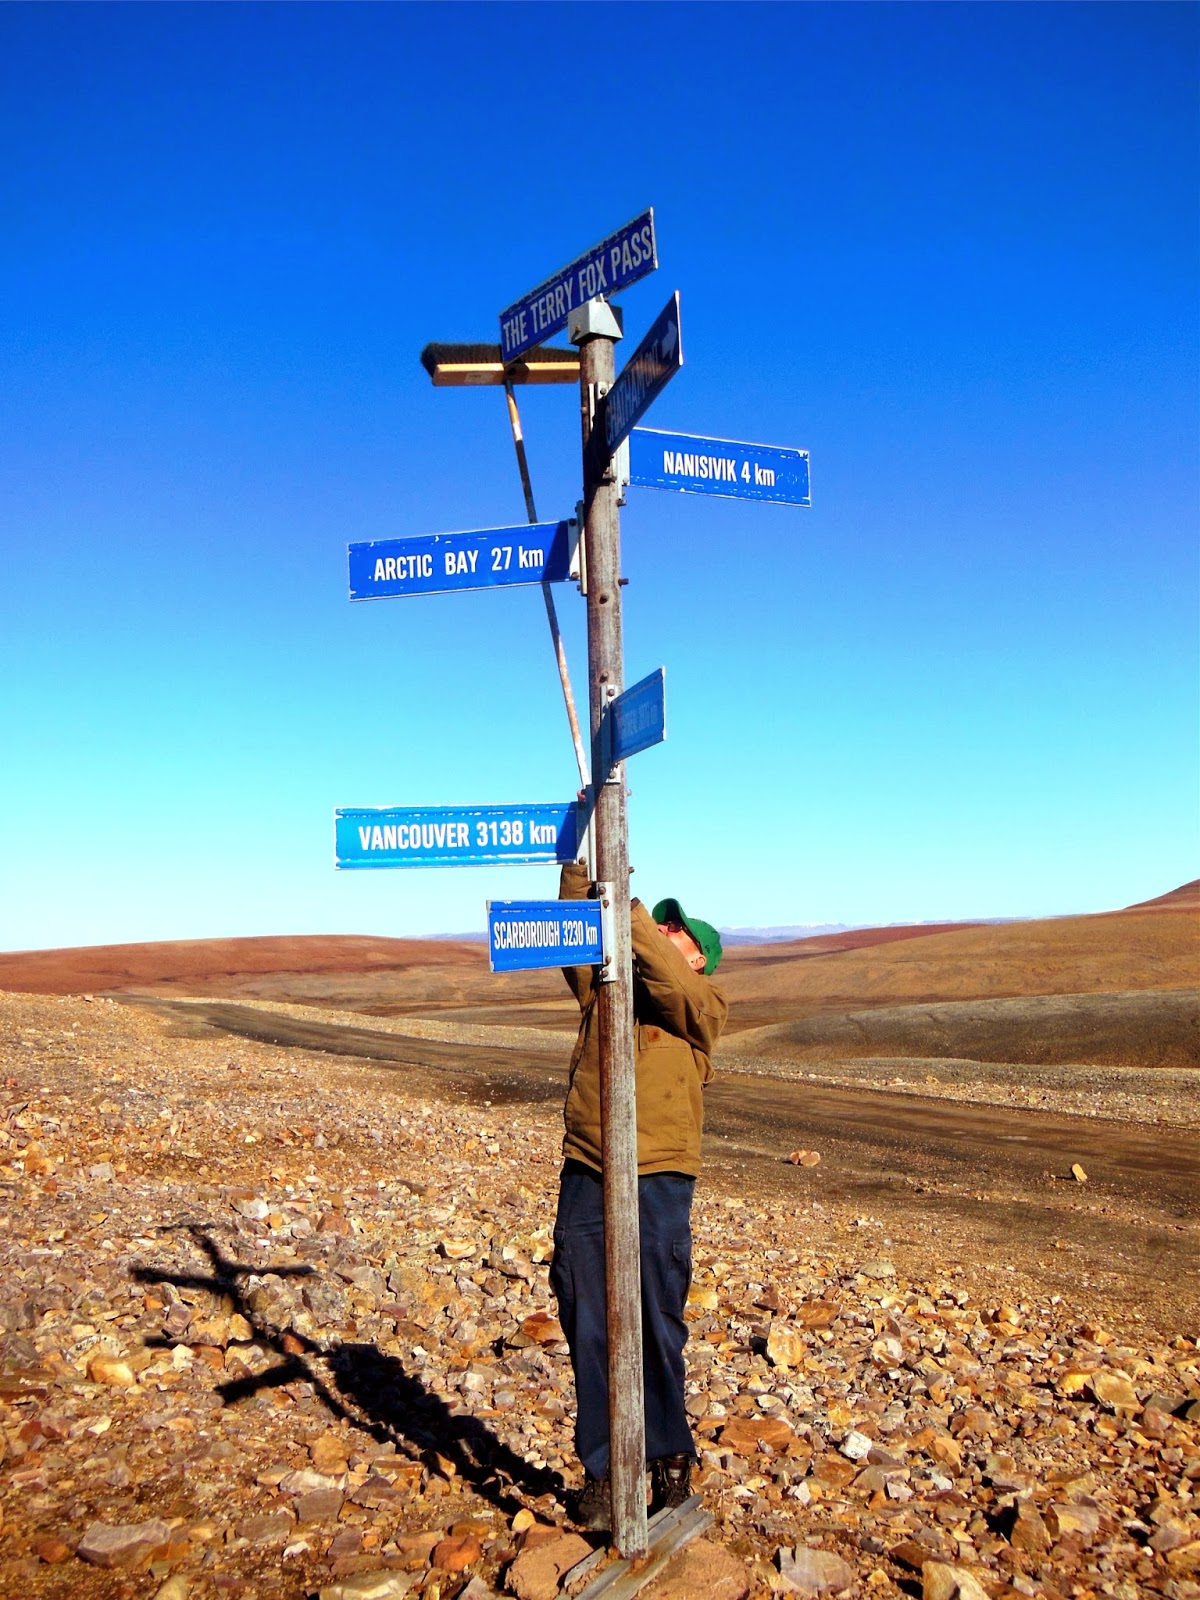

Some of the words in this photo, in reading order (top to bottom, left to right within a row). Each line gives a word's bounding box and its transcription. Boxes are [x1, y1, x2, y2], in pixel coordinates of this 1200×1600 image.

[503, 310, 527, 353] THE
[530, 277, 573, 333] TERRY
[578, 255, 608, 302] FOX
[610, 225, 651, 281] PASS
[605, 354, 646, 447] CHATHAM
[663, 450, 737, 482] NANISIVIK
[741, 461, 751, 484] 4
[754, 463, 775, 486] km
[374, 553, 433, 581] ARCTIC
[445, 549, 479, 575] BAY
[491, 546, 512, 571] 27
[518, 545, 544, 568] km
[358, 822, 470, 850] VANCOUVER
[476, 820, 524, 846] 3138
[530, 820, 557, 845] km
[493, 920, 560, 950] SCARBOROUGH
[562, 919, 584, 947] 3230
[585, 920, 598, 946] km
